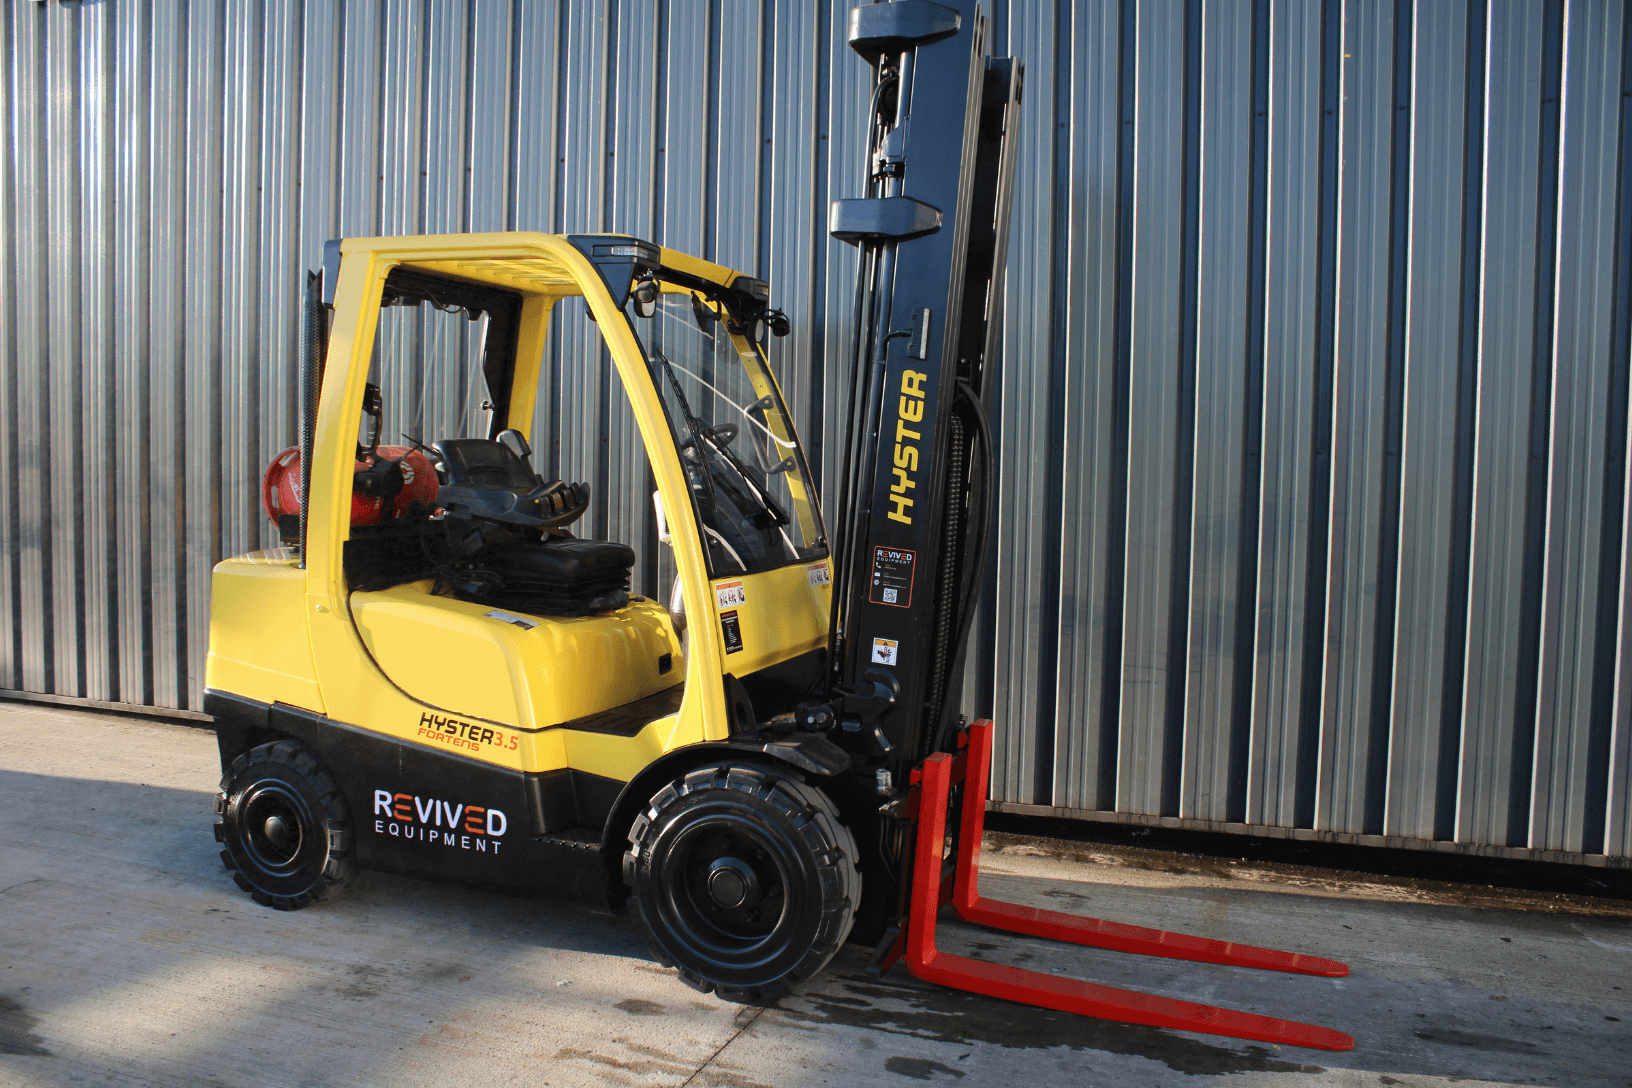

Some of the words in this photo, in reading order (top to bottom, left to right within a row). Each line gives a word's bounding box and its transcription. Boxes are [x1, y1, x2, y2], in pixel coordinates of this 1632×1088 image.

[887, 369, 928, 525] HYSTER
[876, 557, 911, 565] EQUIPMENT
[877, 550, 912, 561] REVIVED
[417, 727, 480, 752] FORTENS
[419, 712, 494, 745] HYSTER
[494, 731, 519, 751] 3.5
[374, 789, 507, 837] REVIVED
[375, 820, 502, 855] EQUIPMENT
